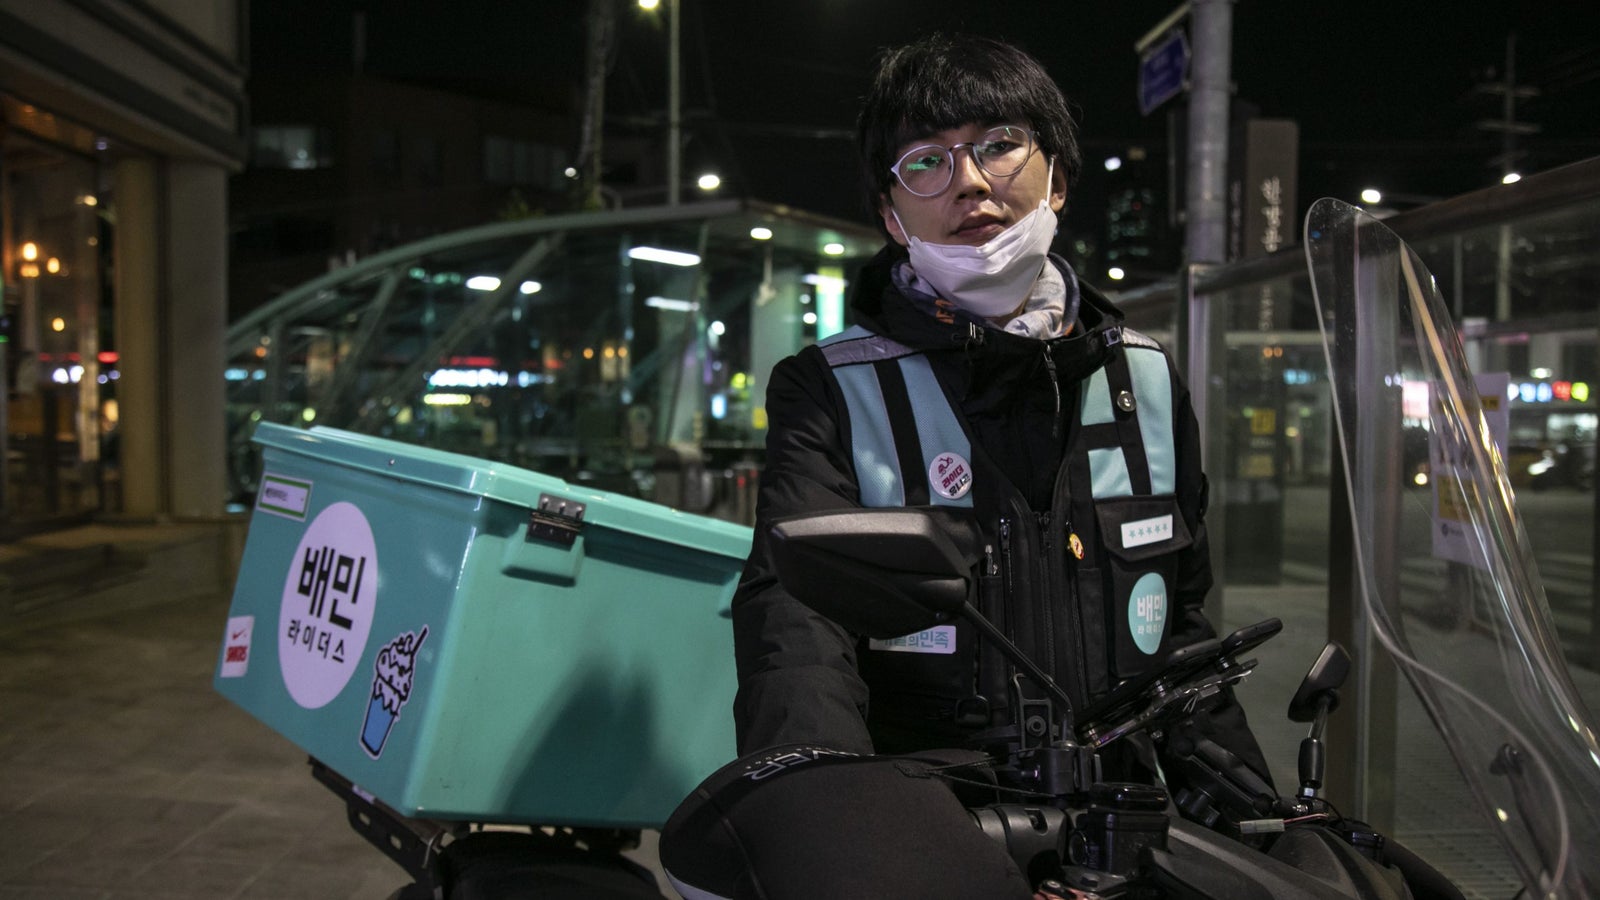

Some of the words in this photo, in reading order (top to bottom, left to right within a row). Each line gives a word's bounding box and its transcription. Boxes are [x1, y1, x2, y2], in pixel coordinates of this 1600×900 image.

[942, 464, 965, 489] 라이더
[297, 546, 366, 631] 배민
[1137, 594, 1163, 621] 배민
[287, 619, 346, 664] 라이더스
